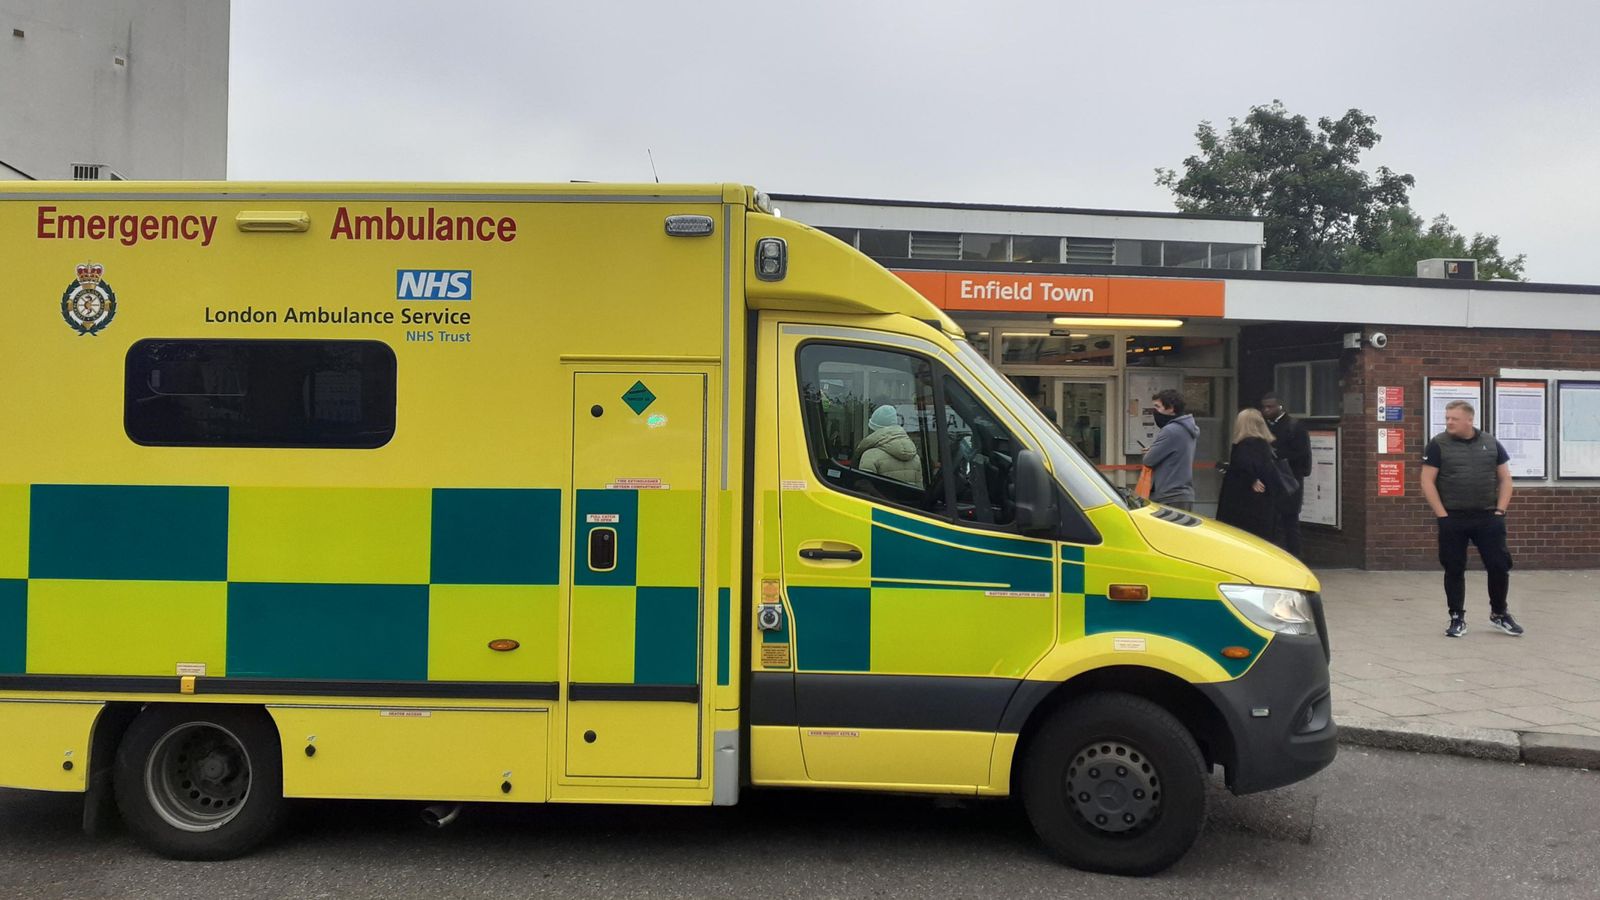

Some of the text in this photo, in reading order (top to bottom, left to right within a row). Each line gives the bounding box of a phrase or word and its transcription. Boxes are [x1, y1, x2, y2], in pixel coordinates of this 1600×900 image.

[37, 206, 517, 246] Emergency Ambulance
[398, 271, 470, 299] NHS
[960, 280, 1094, 302] Enfield Town
[205, 307, 471, 325] London Ambulance Service
[406, 331, 471, 343] NHS Trust
